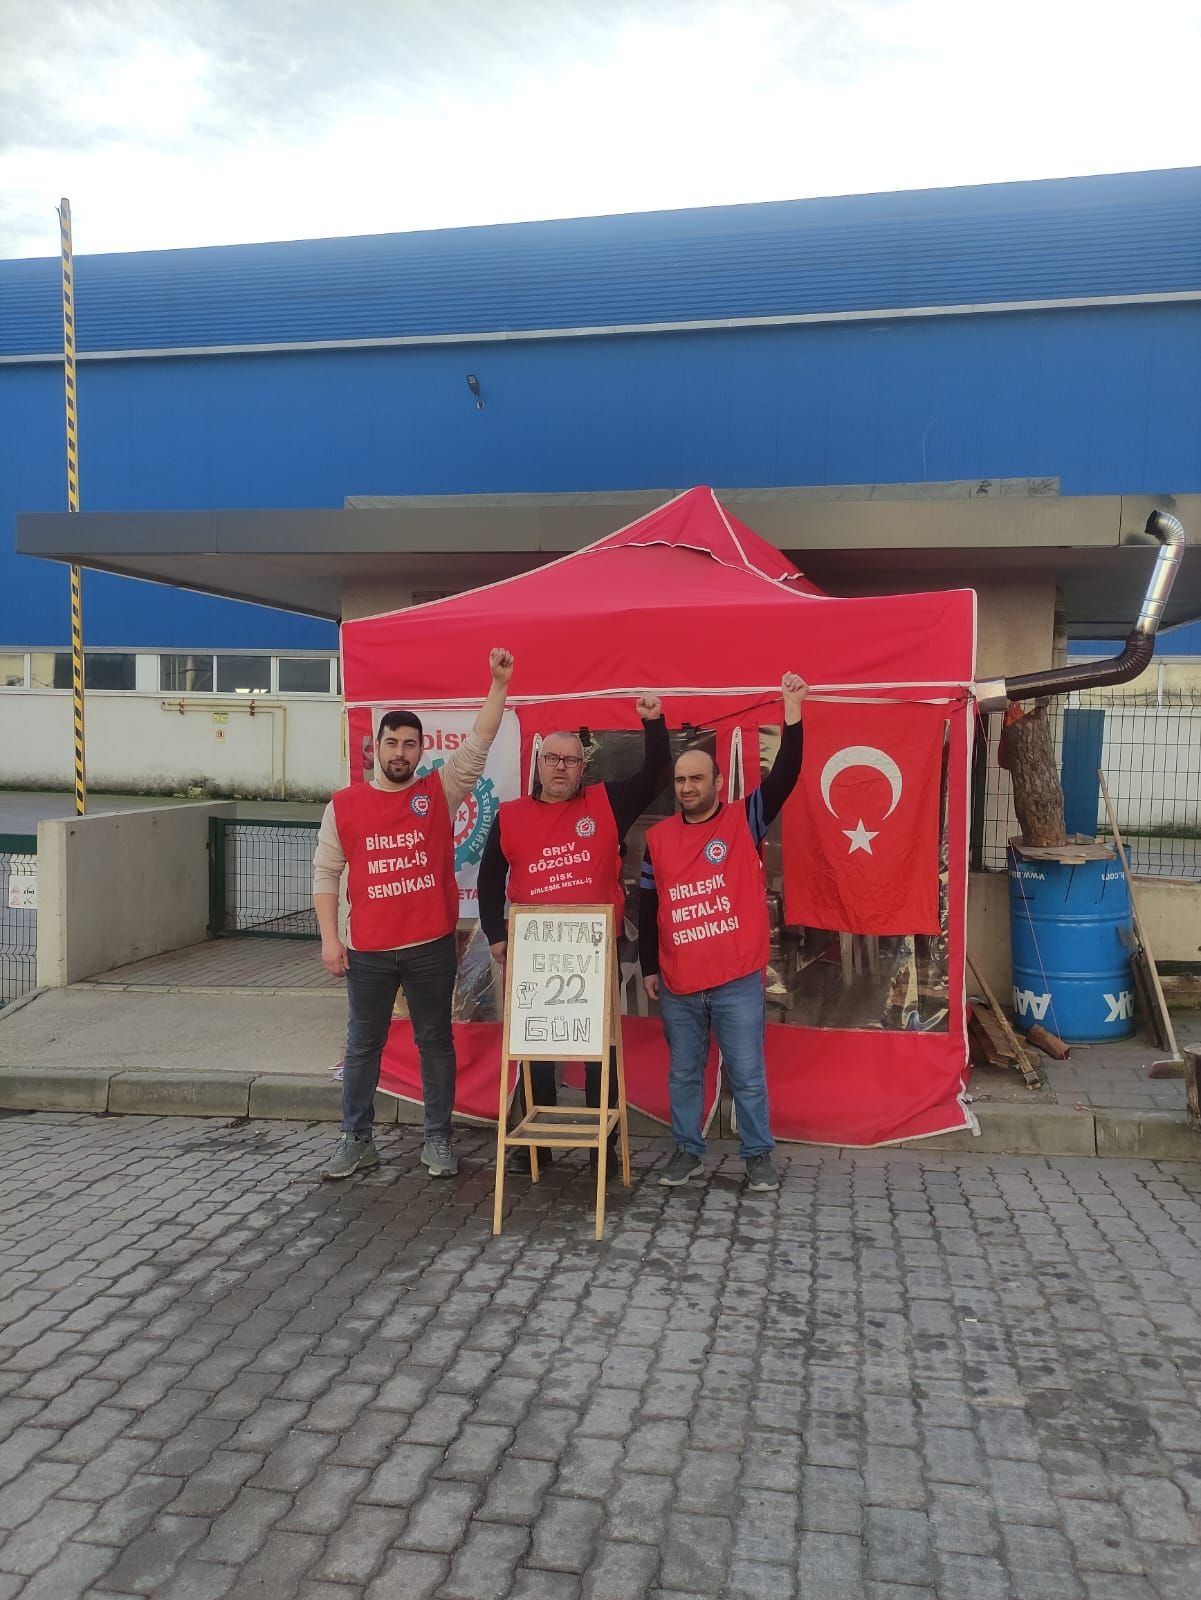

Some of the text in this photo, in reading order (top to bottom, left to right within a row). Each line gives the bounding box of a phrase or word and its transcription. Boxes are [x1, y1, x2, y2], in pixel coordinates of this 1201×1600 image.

[528, 849, 591, 874] GÖZCÜSÜ
[542, 841, 576, 857] GREV
[367, 850, 428, 875] METAL-İŞ
[367, 873, 436, 899] SENDİKASI
[458, 888, 479, 900] ETA
[668, 873, 726, 902] BİRLEŞİK
[671, 895, 731, 924] METAL-İŞ
[672, 915, 740, 946] SENDİKASI
[532, 950, 600, 974] GREVİ
[544, 973, 588, 1006] 22
[524, 1016, 591, 1043] GÜN
